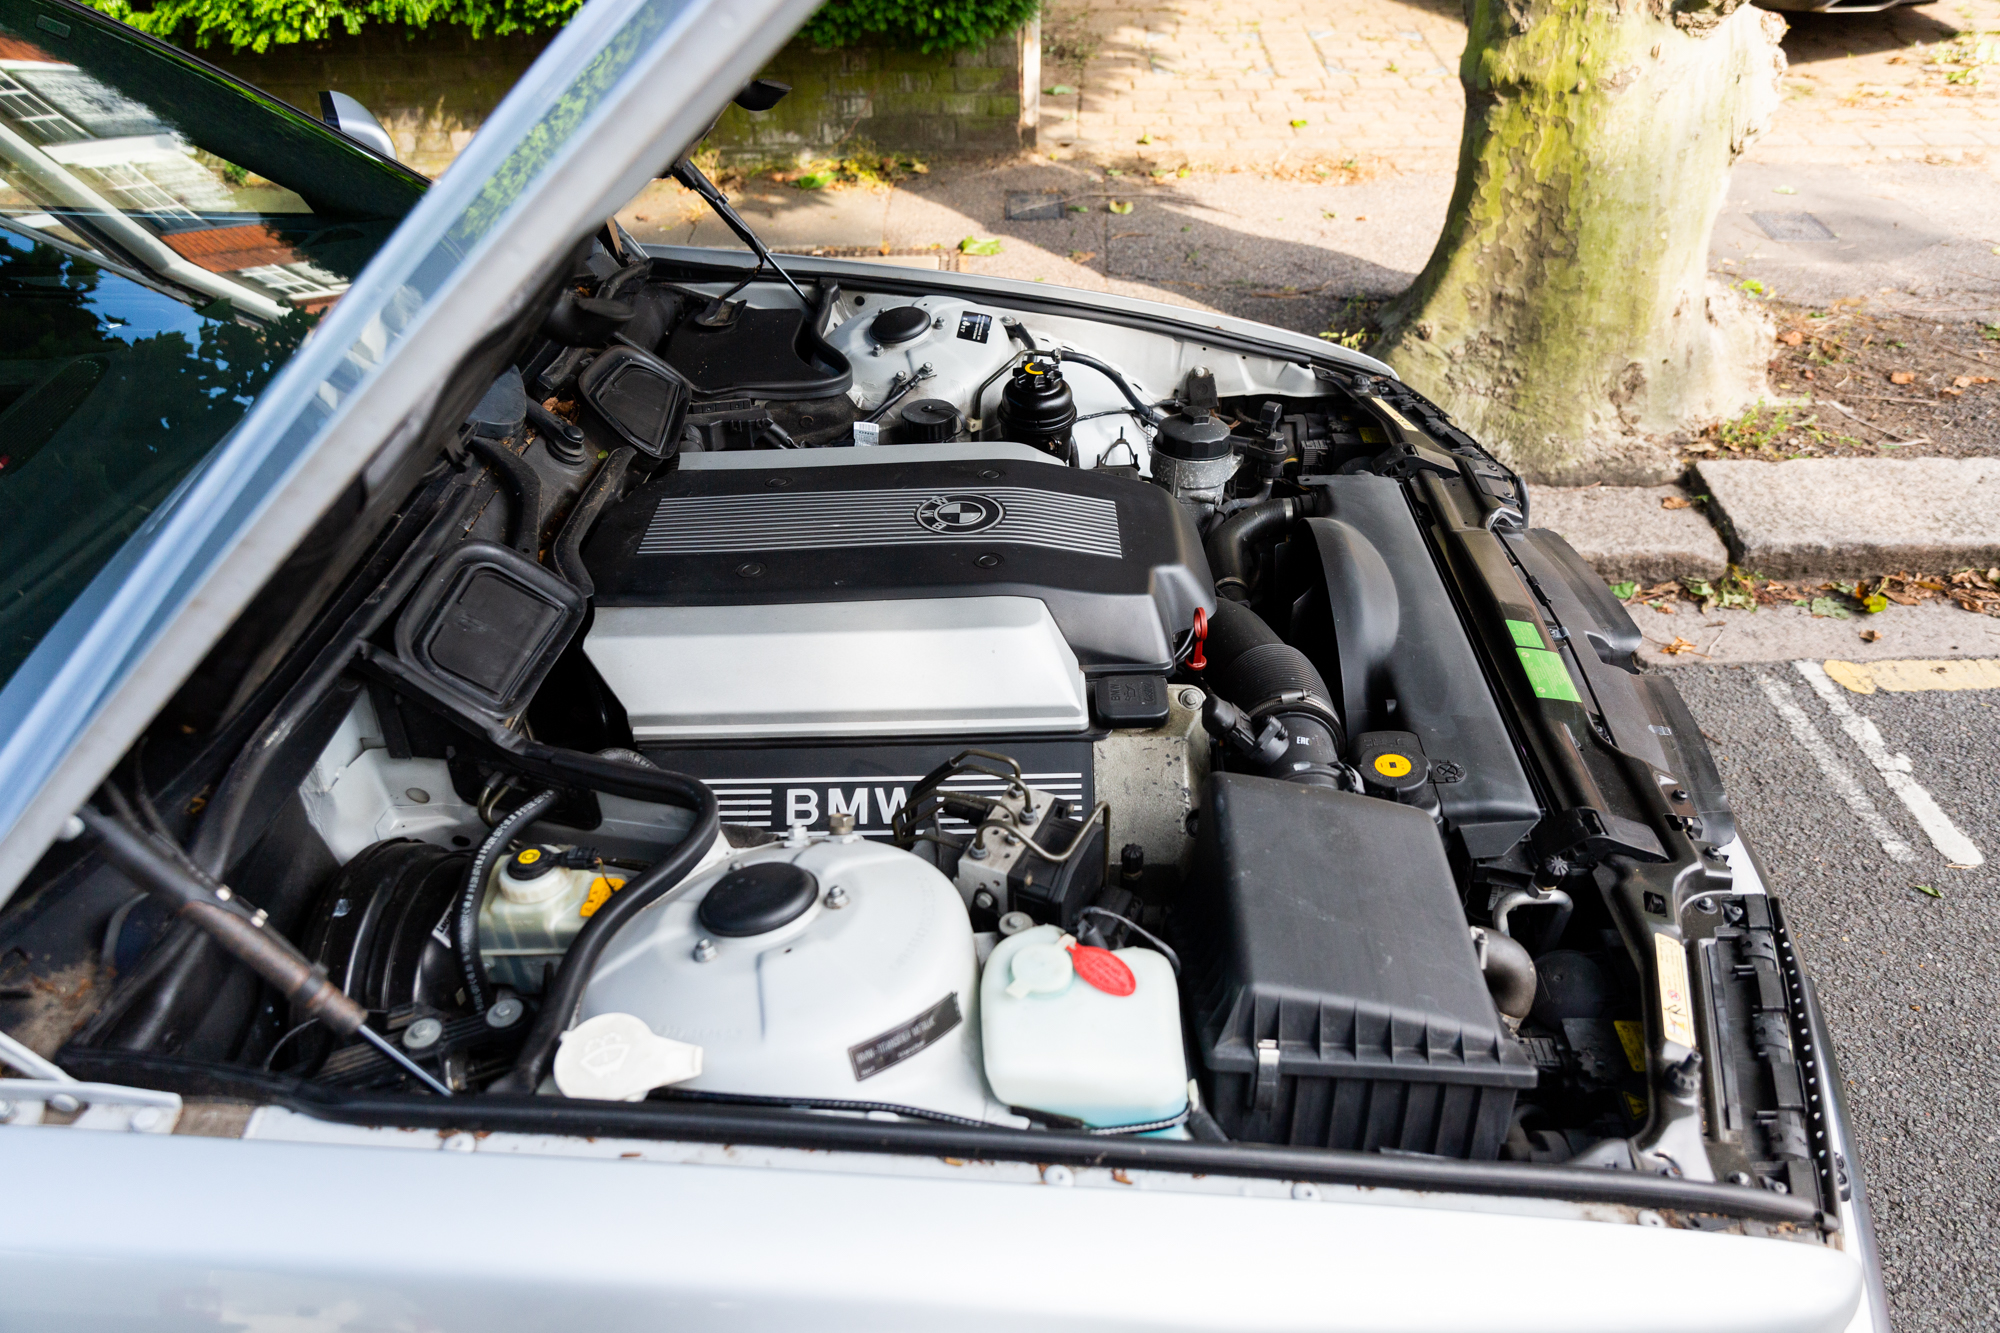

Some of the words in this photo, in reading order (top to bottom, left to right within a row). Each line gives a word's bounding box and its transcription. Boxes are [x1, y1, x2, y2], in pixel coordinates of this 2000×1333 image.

[920, 496, 949, 530] BMW
[1110, 683, 1121, 701] BMW
[786, 787, 908, 826] BMW
